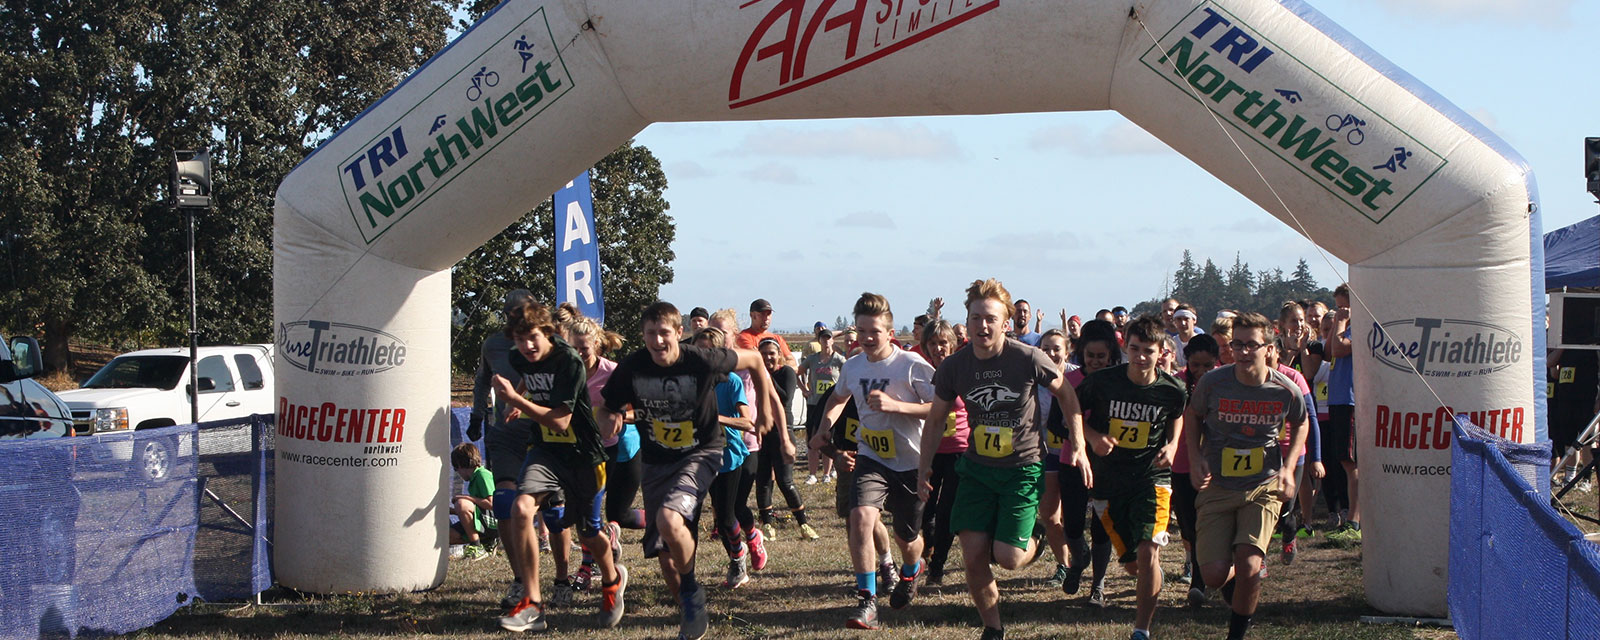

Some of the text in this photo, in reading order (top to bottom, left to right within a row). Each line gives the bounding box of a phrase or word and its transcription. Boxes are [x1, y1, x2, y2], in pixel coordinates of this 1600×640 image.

[1190, 7, 1274, 74] TRI
[1158, 36, 1394, 211] NorthWest
[358, 59, 561, 229] NorthWest
[344, 126, 408, 191] TRI
[320, 368, 336, 376] SWIM
[1431, 367, 1493, 377] SWIM BIKE RUN
[1109, 400, 1163, 422] HUSKY
[1218, 398, 1284, 415] BEAVER
[1218, 412, 1281, 425] FOOTBALL
[662, 427, 682, 442] 72
[984, 433, 1001, 451] 74
[1119, 426, 1138, 442] 73
[364, 444, 402, 454] northwest
[865, 434, 889, 452] 109
[281, 451, 398, 467] www.racecenter.com
[1233, 455, 1251, 471] 71
